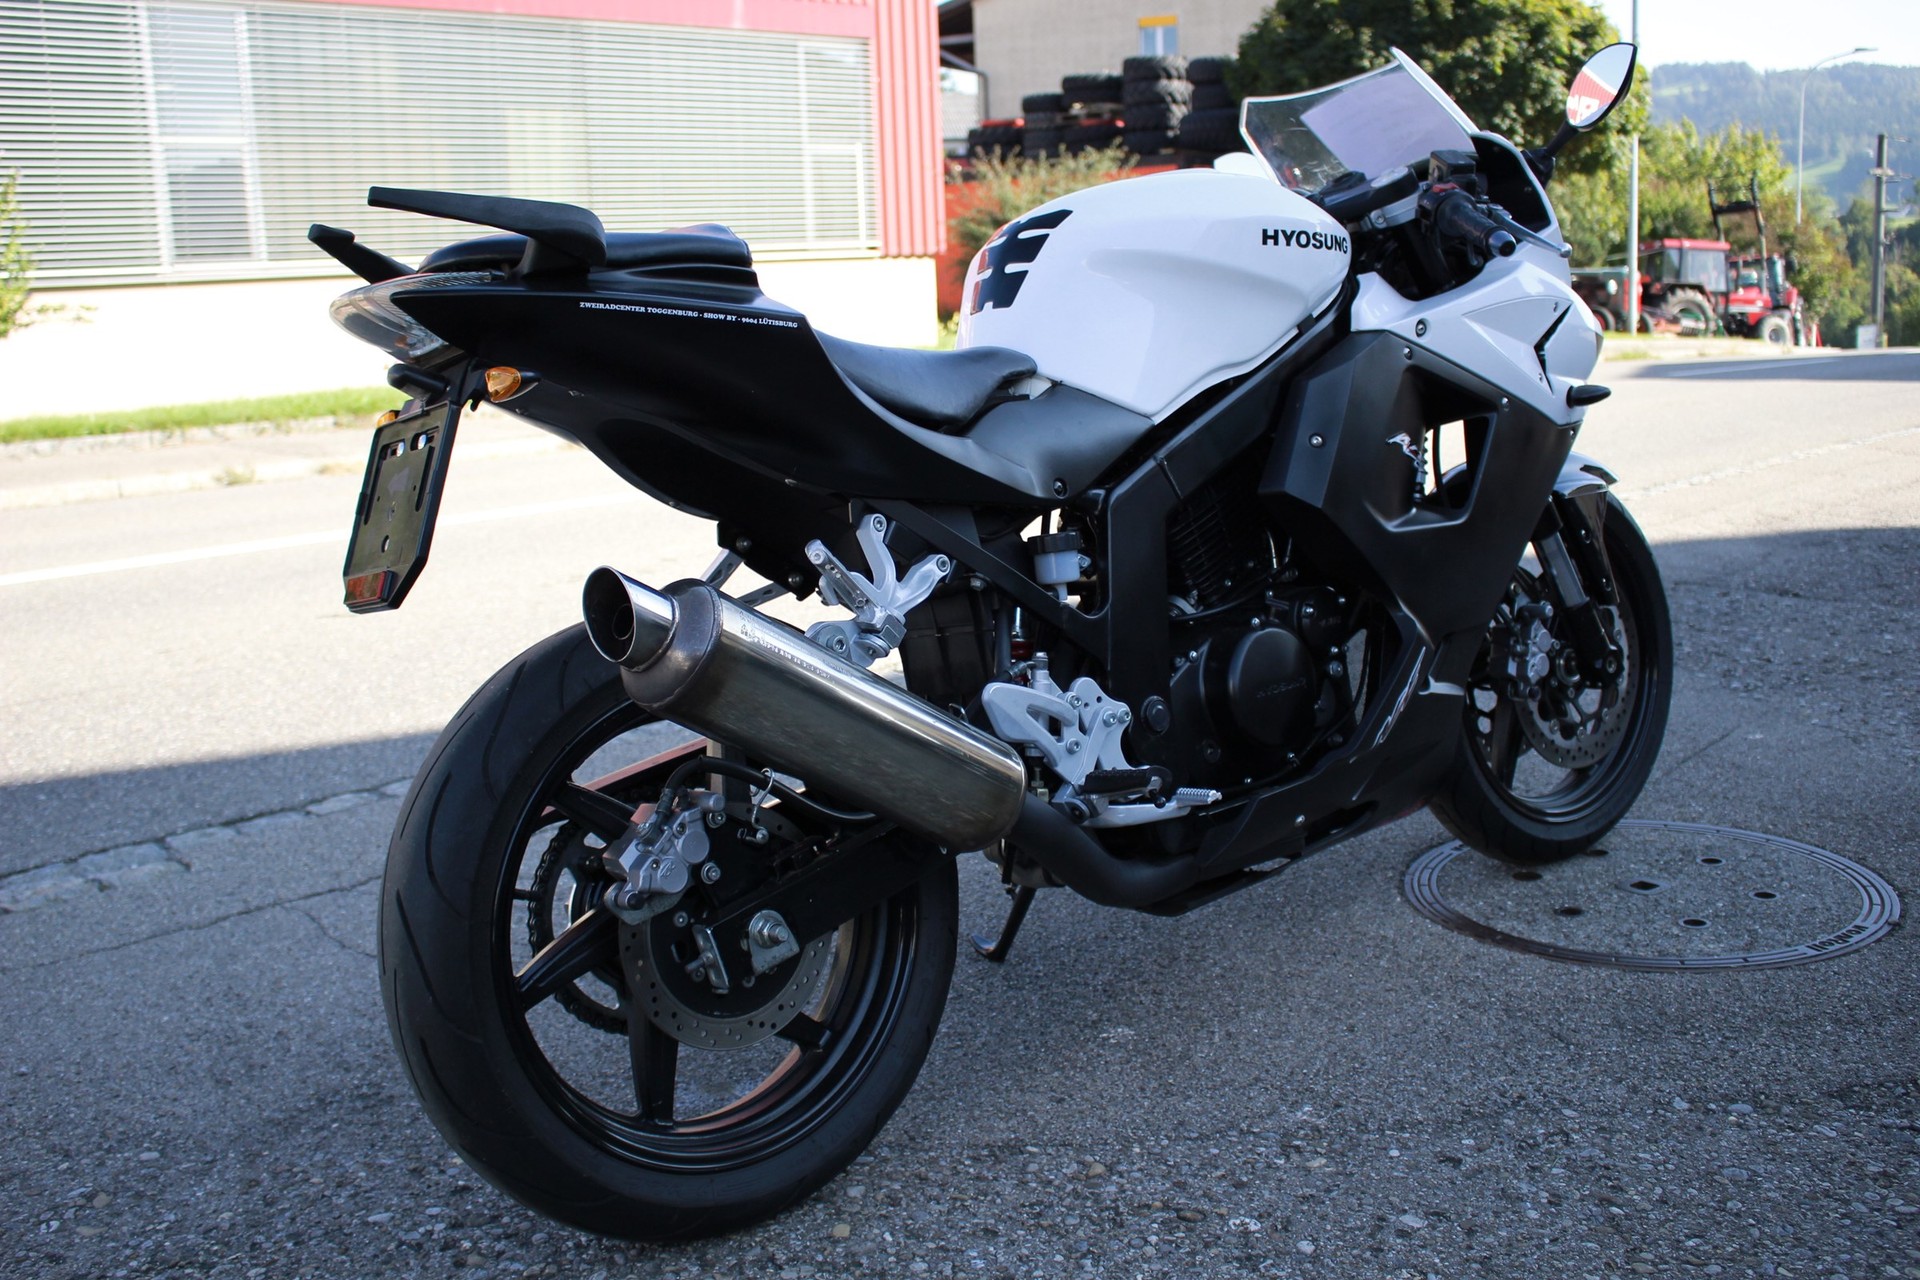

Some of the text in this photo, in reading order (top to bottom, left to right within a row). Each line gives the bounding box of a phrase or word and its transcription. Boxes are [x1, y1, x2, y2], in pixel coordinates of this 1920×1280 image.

[1262, 228, 1348, 254] HYOSUNG
[579, 301, 646, 313] ZWEIRADCENTER
[647, 307, 699, 317] TOGGENBURG
[703, 312, 725, 321] SHOW
[759, 317, 798, 328] LÜTISBURG
